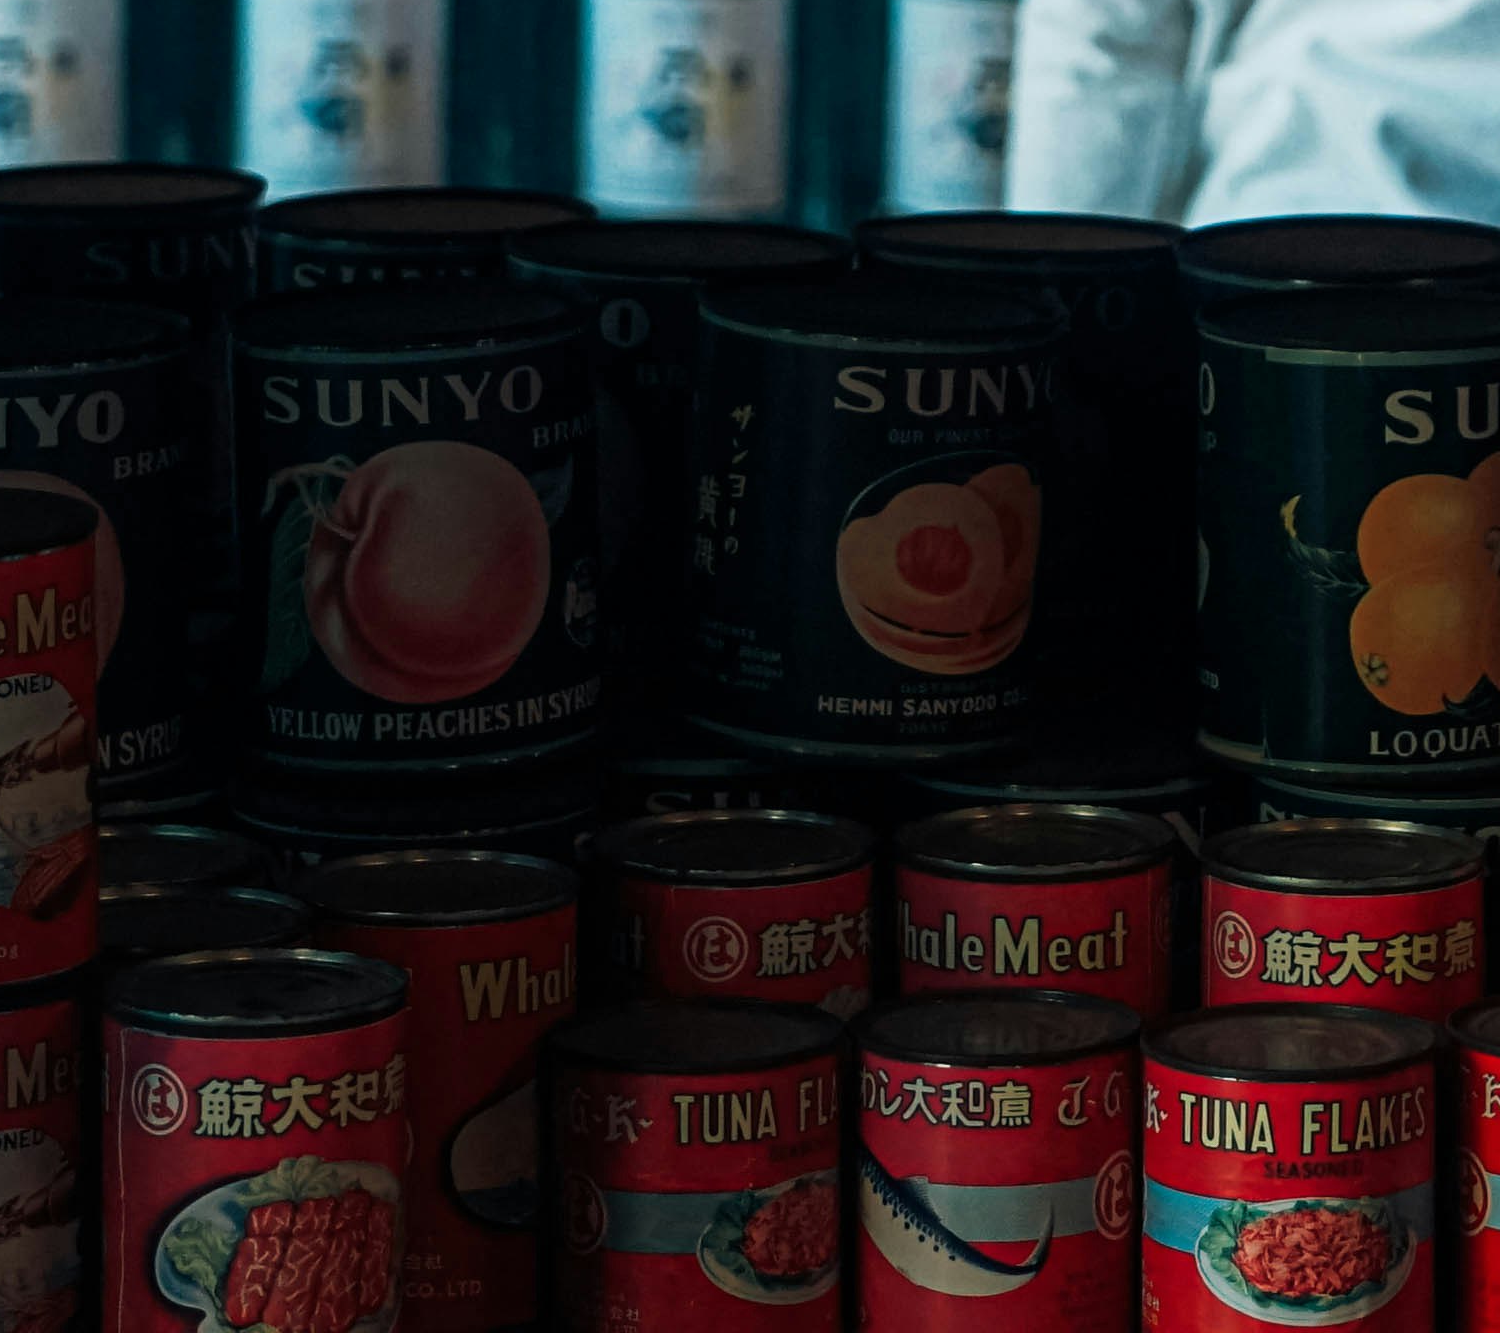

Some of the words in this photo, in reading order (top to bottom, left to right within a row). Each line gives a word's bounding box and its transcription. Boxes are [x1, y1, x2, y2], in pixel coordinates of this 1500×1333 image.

[262, 364, 544, 429] SUNYO
[887, 428, 924, 447] OUR
[727, 402, 757, 557] サンヨーの
[267, 705, 365, 743] YELLOW
[373, 703, 513, 742] PEACHES
[516, 698, 544, 731] IN
[817, 694, 893, 718] HEMMI
[902, 690, 998, 716] SANYODO
[993, 909, 1129, 975] Meat
[1261, 920, 1477, 987] 鯨大和煮
[673, 1089, 779, 1146] TUNA
[1180, 1092, 1274, 1155] TUNA
[1301, 1085, 1427, 1156] FLAKES
